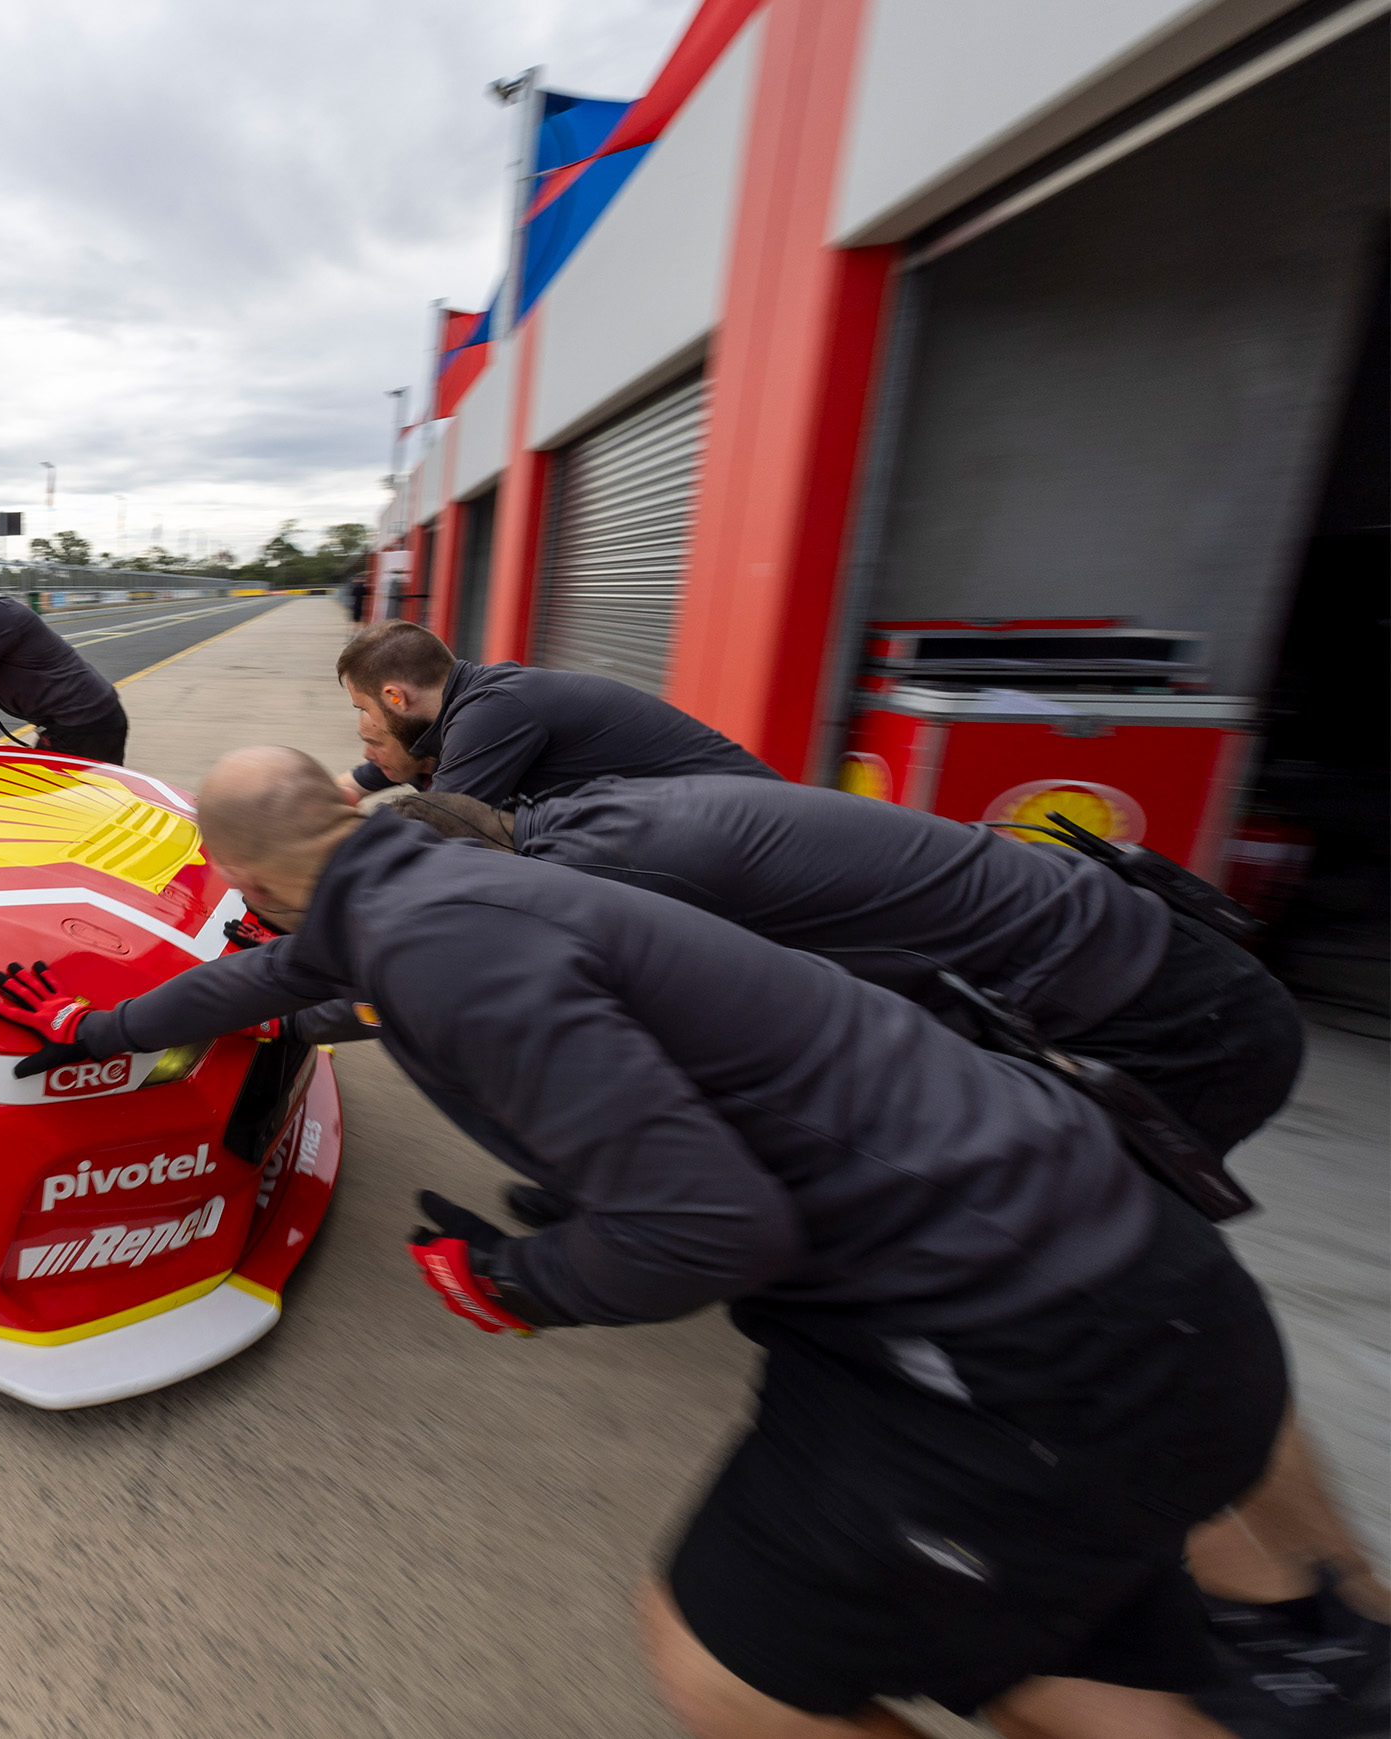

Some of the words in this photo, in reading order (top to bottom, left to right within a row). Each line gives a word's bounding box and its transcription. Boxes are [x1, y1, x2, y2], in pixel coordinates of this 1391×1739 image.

[49, 1059, 127, 1091] CRC
[41, 1142, 217, 1212] pivotel.
[295, 1118, 323, 1177] TYRES
[69, 1195, 226, 1272] Repco
